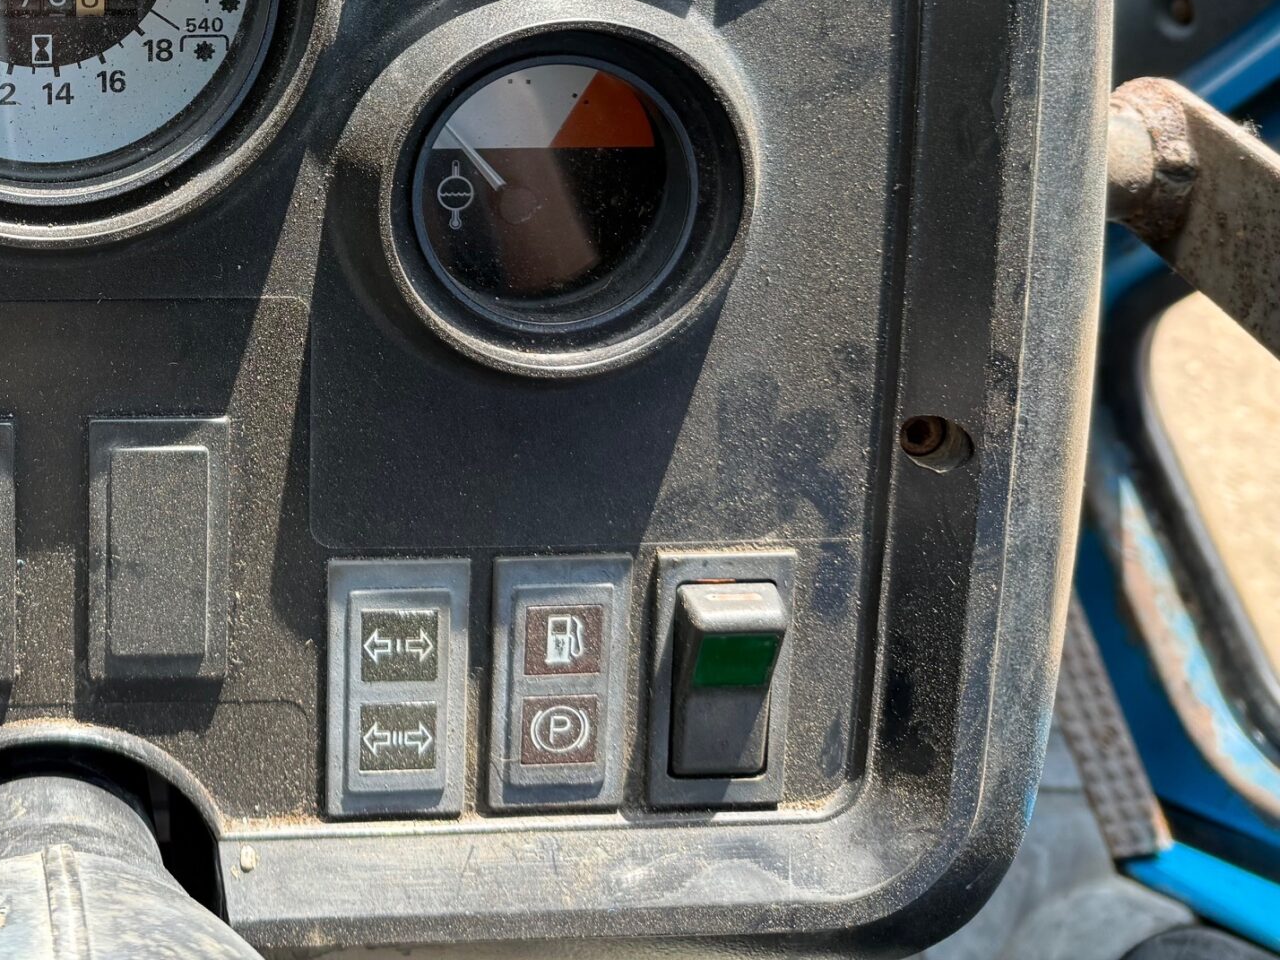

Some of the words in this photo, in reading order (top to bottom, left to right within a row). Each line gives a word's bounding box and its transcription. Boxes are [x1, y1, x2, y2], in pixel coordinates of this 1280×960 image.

[185, 17, 224, 32] 540
[144, 39, 174, 62] 18
[42, 82, 74, 105] 14
[97, 70, 127, 94] 16
[549, 714, 571, 744] P
